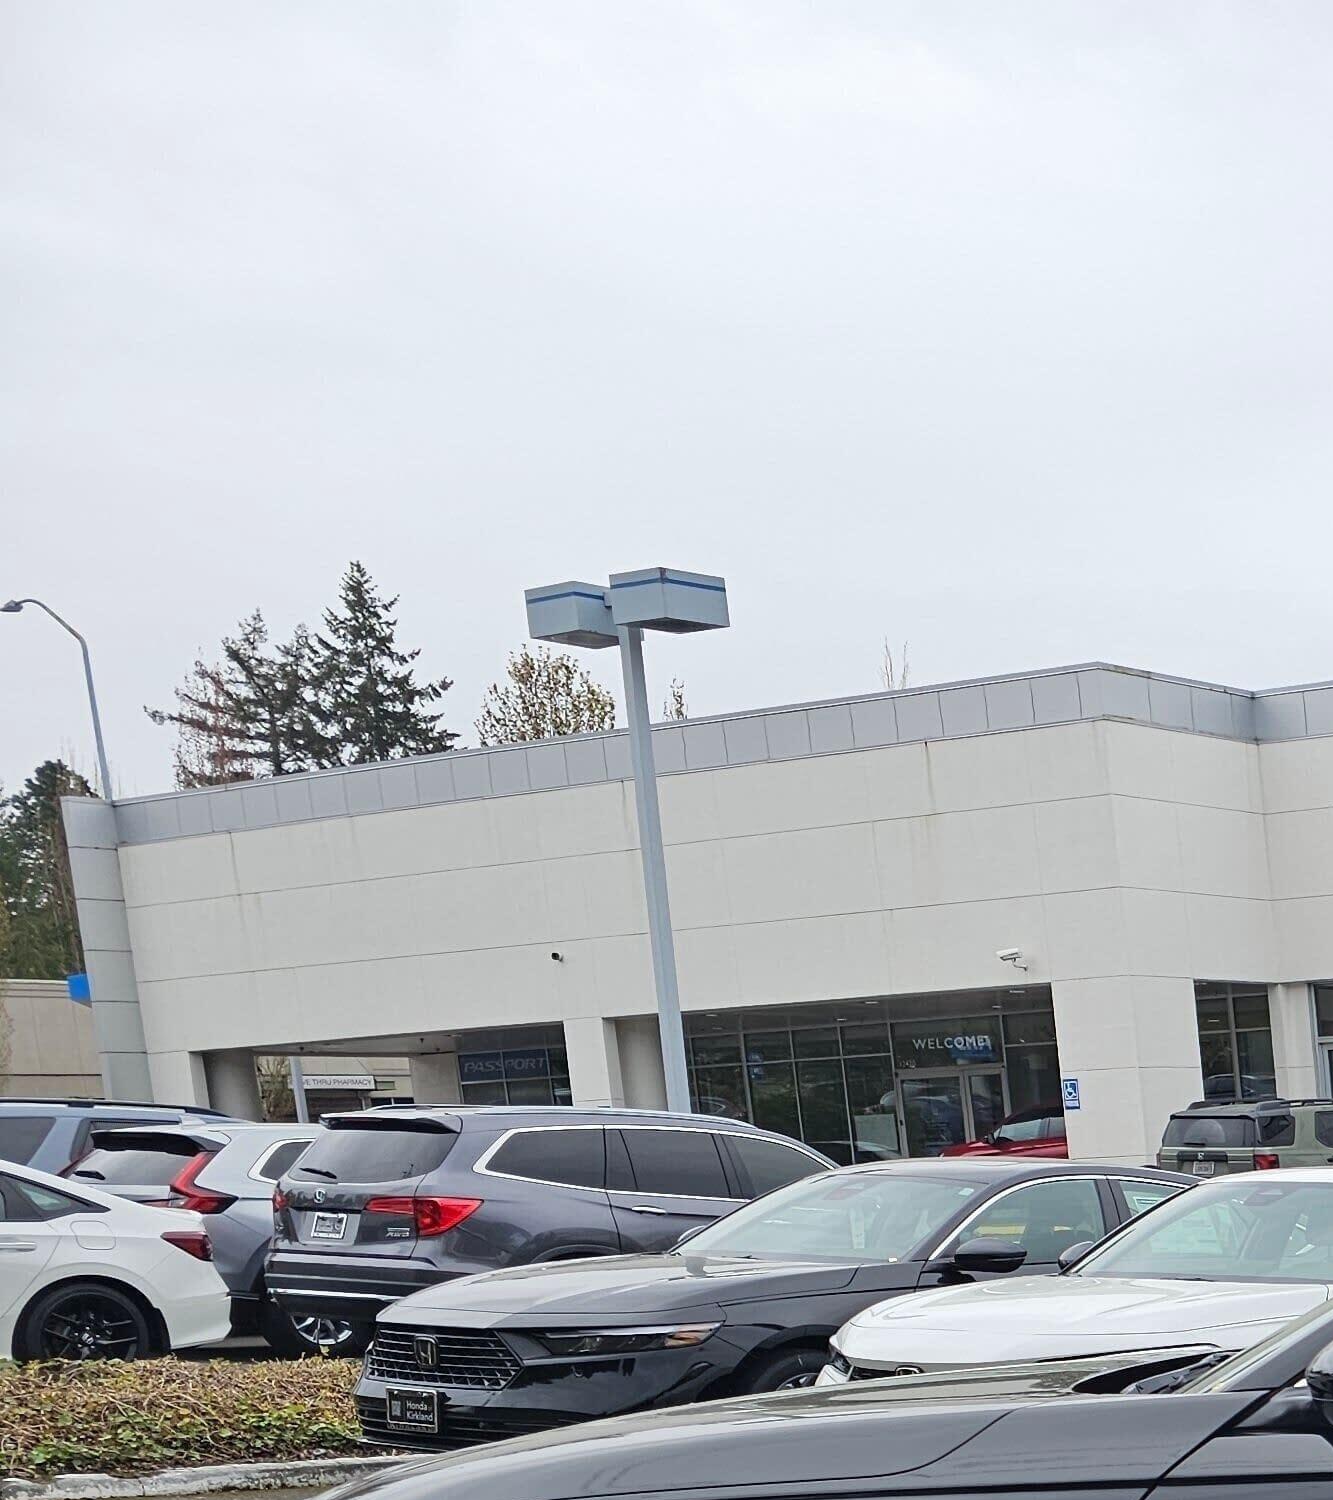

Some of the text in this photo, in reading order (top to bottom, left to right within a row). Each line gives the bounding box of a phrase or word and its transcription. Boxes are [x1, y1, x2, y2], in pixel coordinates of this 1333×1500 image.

[912, 1034, 986, 1050] WELCOME
[463, 1057, 546, 1074] PASSPORT
[406, 1400, 428, 1411] Honda
[406, 1410, 433, 1422] Kirkland
